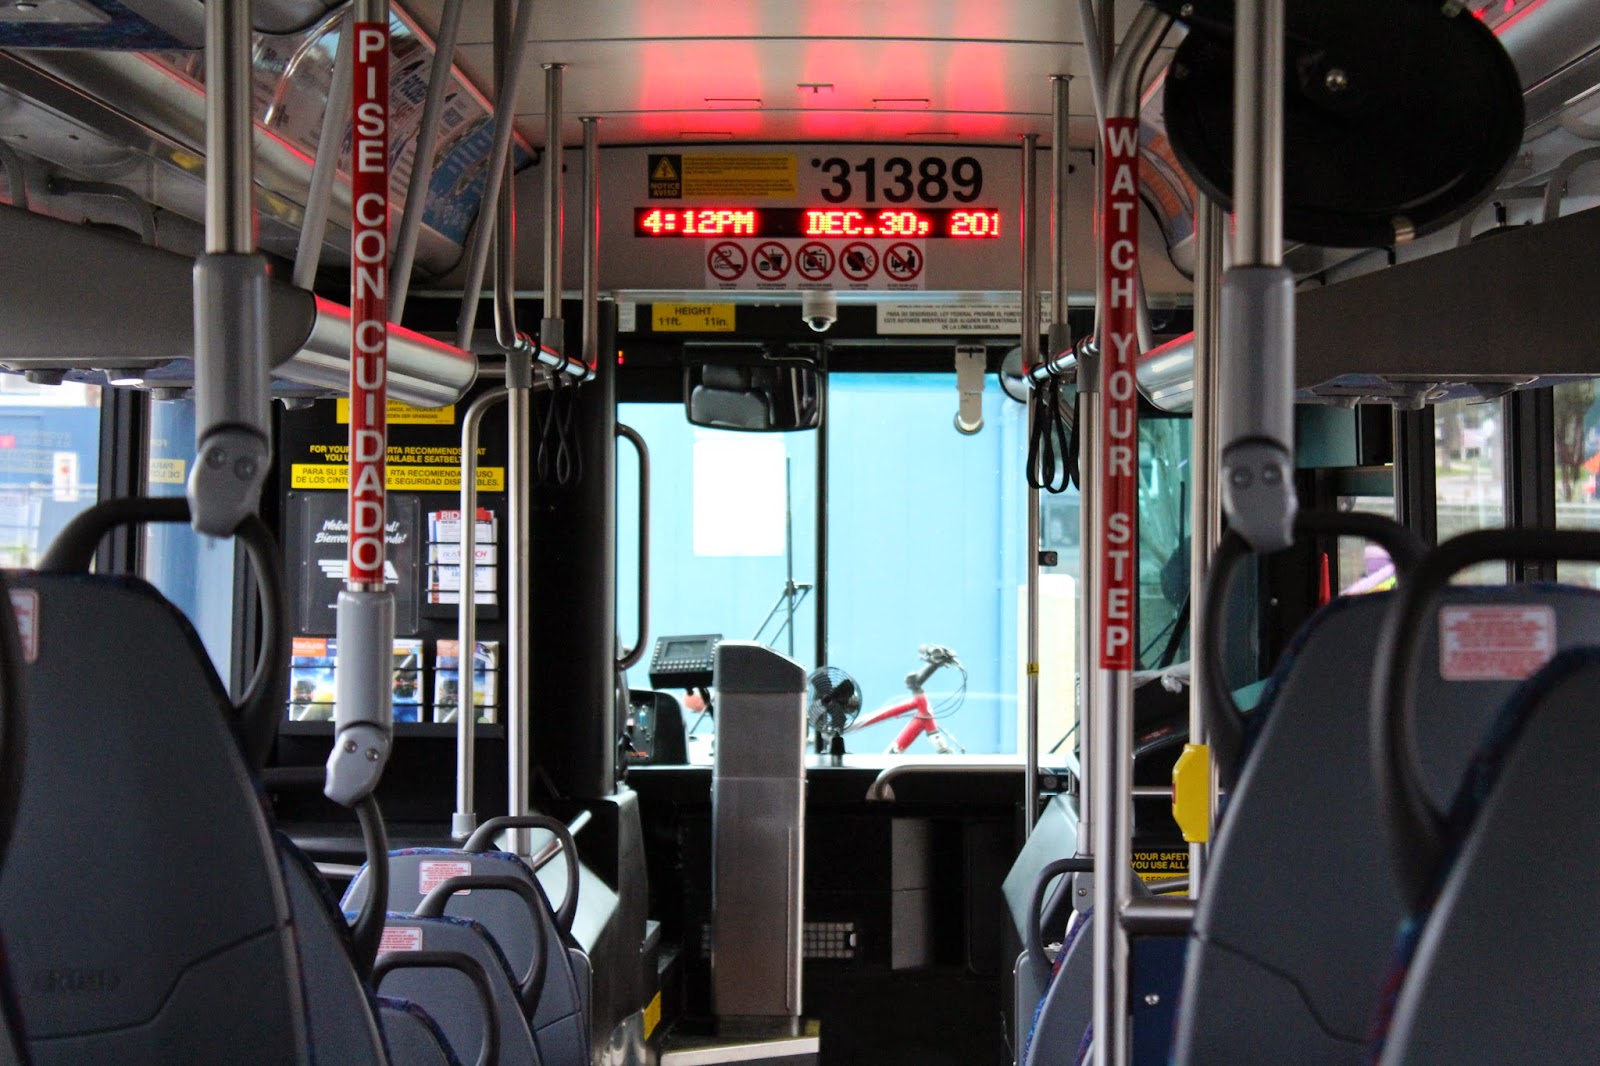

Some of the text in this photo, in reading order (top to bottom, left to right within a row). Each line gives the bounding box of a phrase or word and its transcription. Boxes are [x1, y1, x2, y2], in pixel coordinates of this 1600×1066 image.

[357, 29, 386, 173] PISE
[820, 156, 984, 204] 31389
[642, 209, 755, 235] 4:12PM
[1107, 126, 1139, 309] WATCH
[355, 192, 387, 300] CON
[674, 306, 713, 316] HEIGHT
[1107, 331, 1135, 478] YOUR
[309, 445, 328, 454] FOR
[387, 446, 404, 455] RTA
[404, 447, 462, 456] RECOMMENDS
[324, 454, 343, 462] YOU
[386, 455, 422, 463] VAILABLE
[423, 455, 462, 464] SEATBELT
[351, 319, 385, 572] CUIDADO
[295, 476, 308, 484] DE
[308, 476, 326, 484] LOS
[1106, 511, 1130, 657] STEP
[1131, 861, 1185, 870] YOU USE ALL
[1134, 852, 1190, 861] YOUR SAFETY
